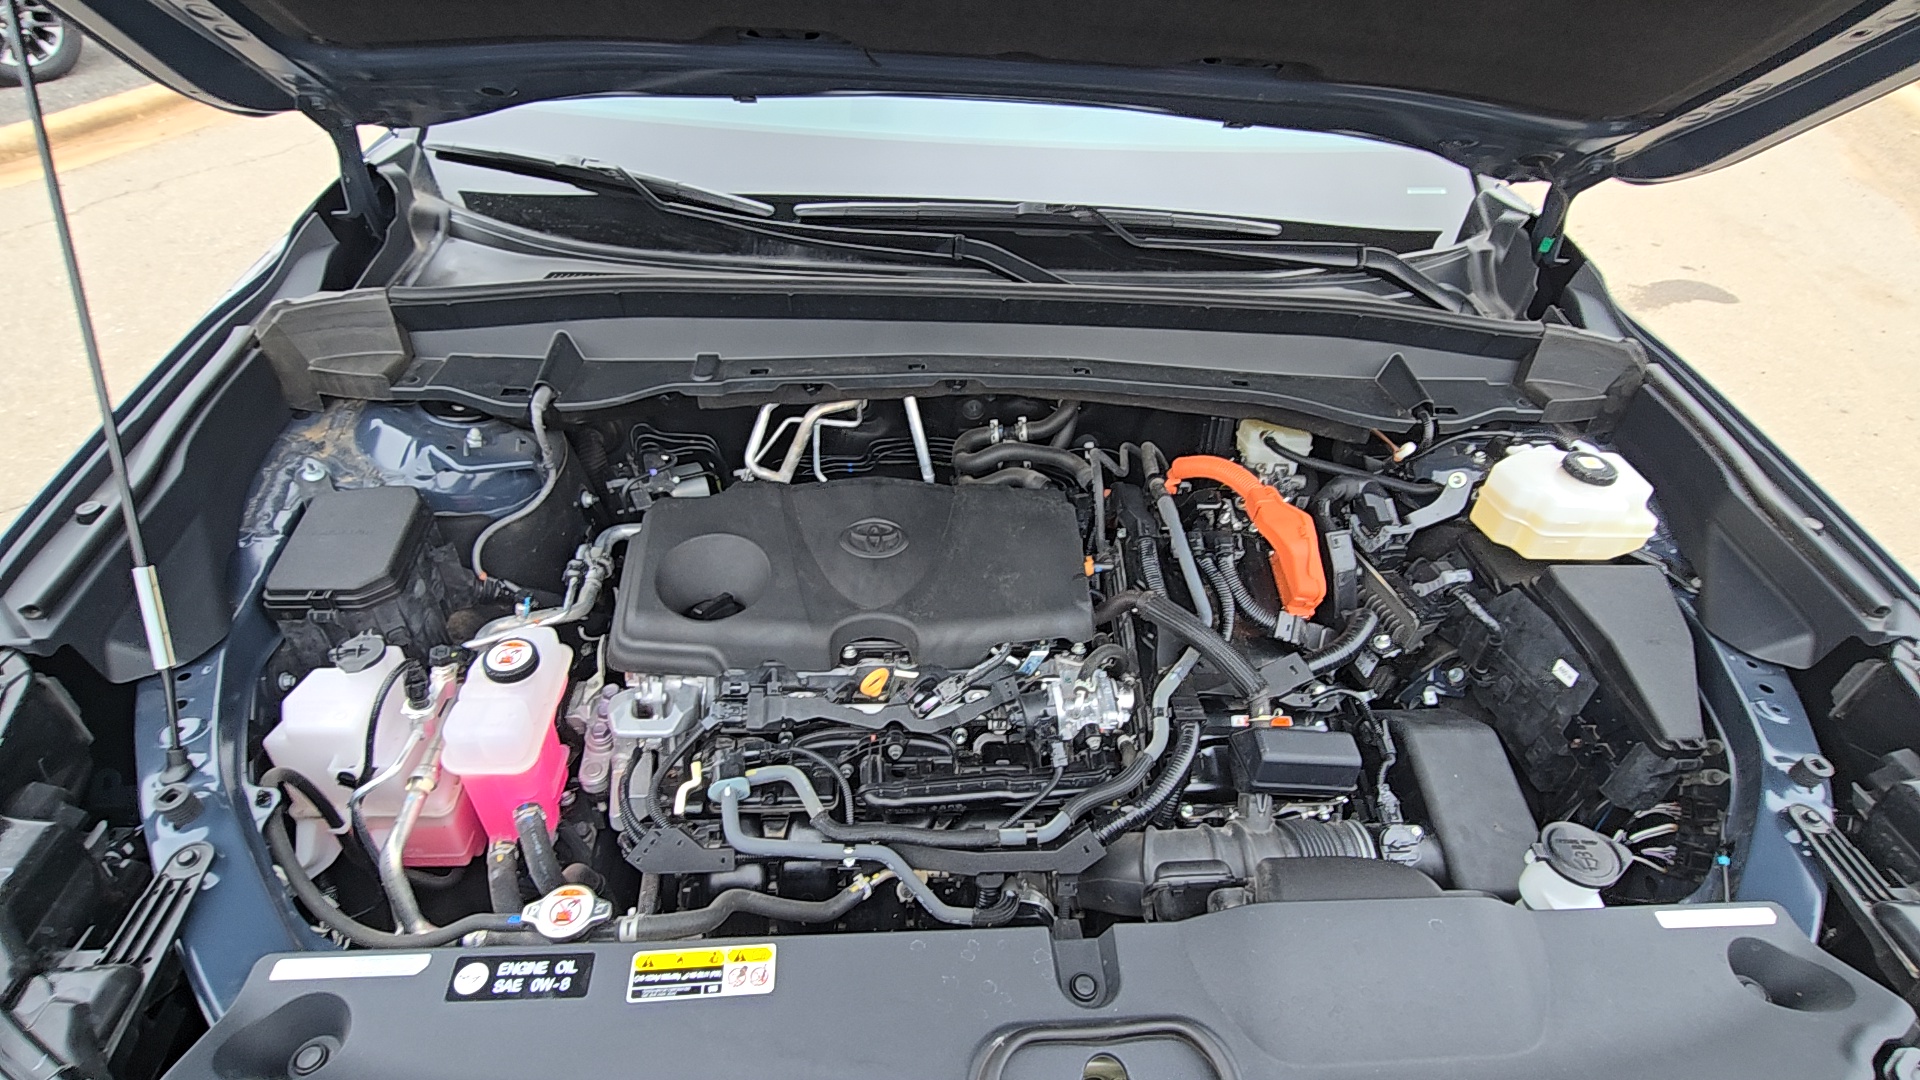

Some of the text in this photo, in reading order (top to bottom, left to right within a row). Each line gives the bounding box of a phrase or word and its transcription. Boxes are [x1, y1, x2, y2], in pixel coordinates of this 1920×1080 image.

[496, 960, 579, 976] ENGINE OIL
[492, 977, 525, 994] SAE
[530, 976, 572, 993] 0W-8
